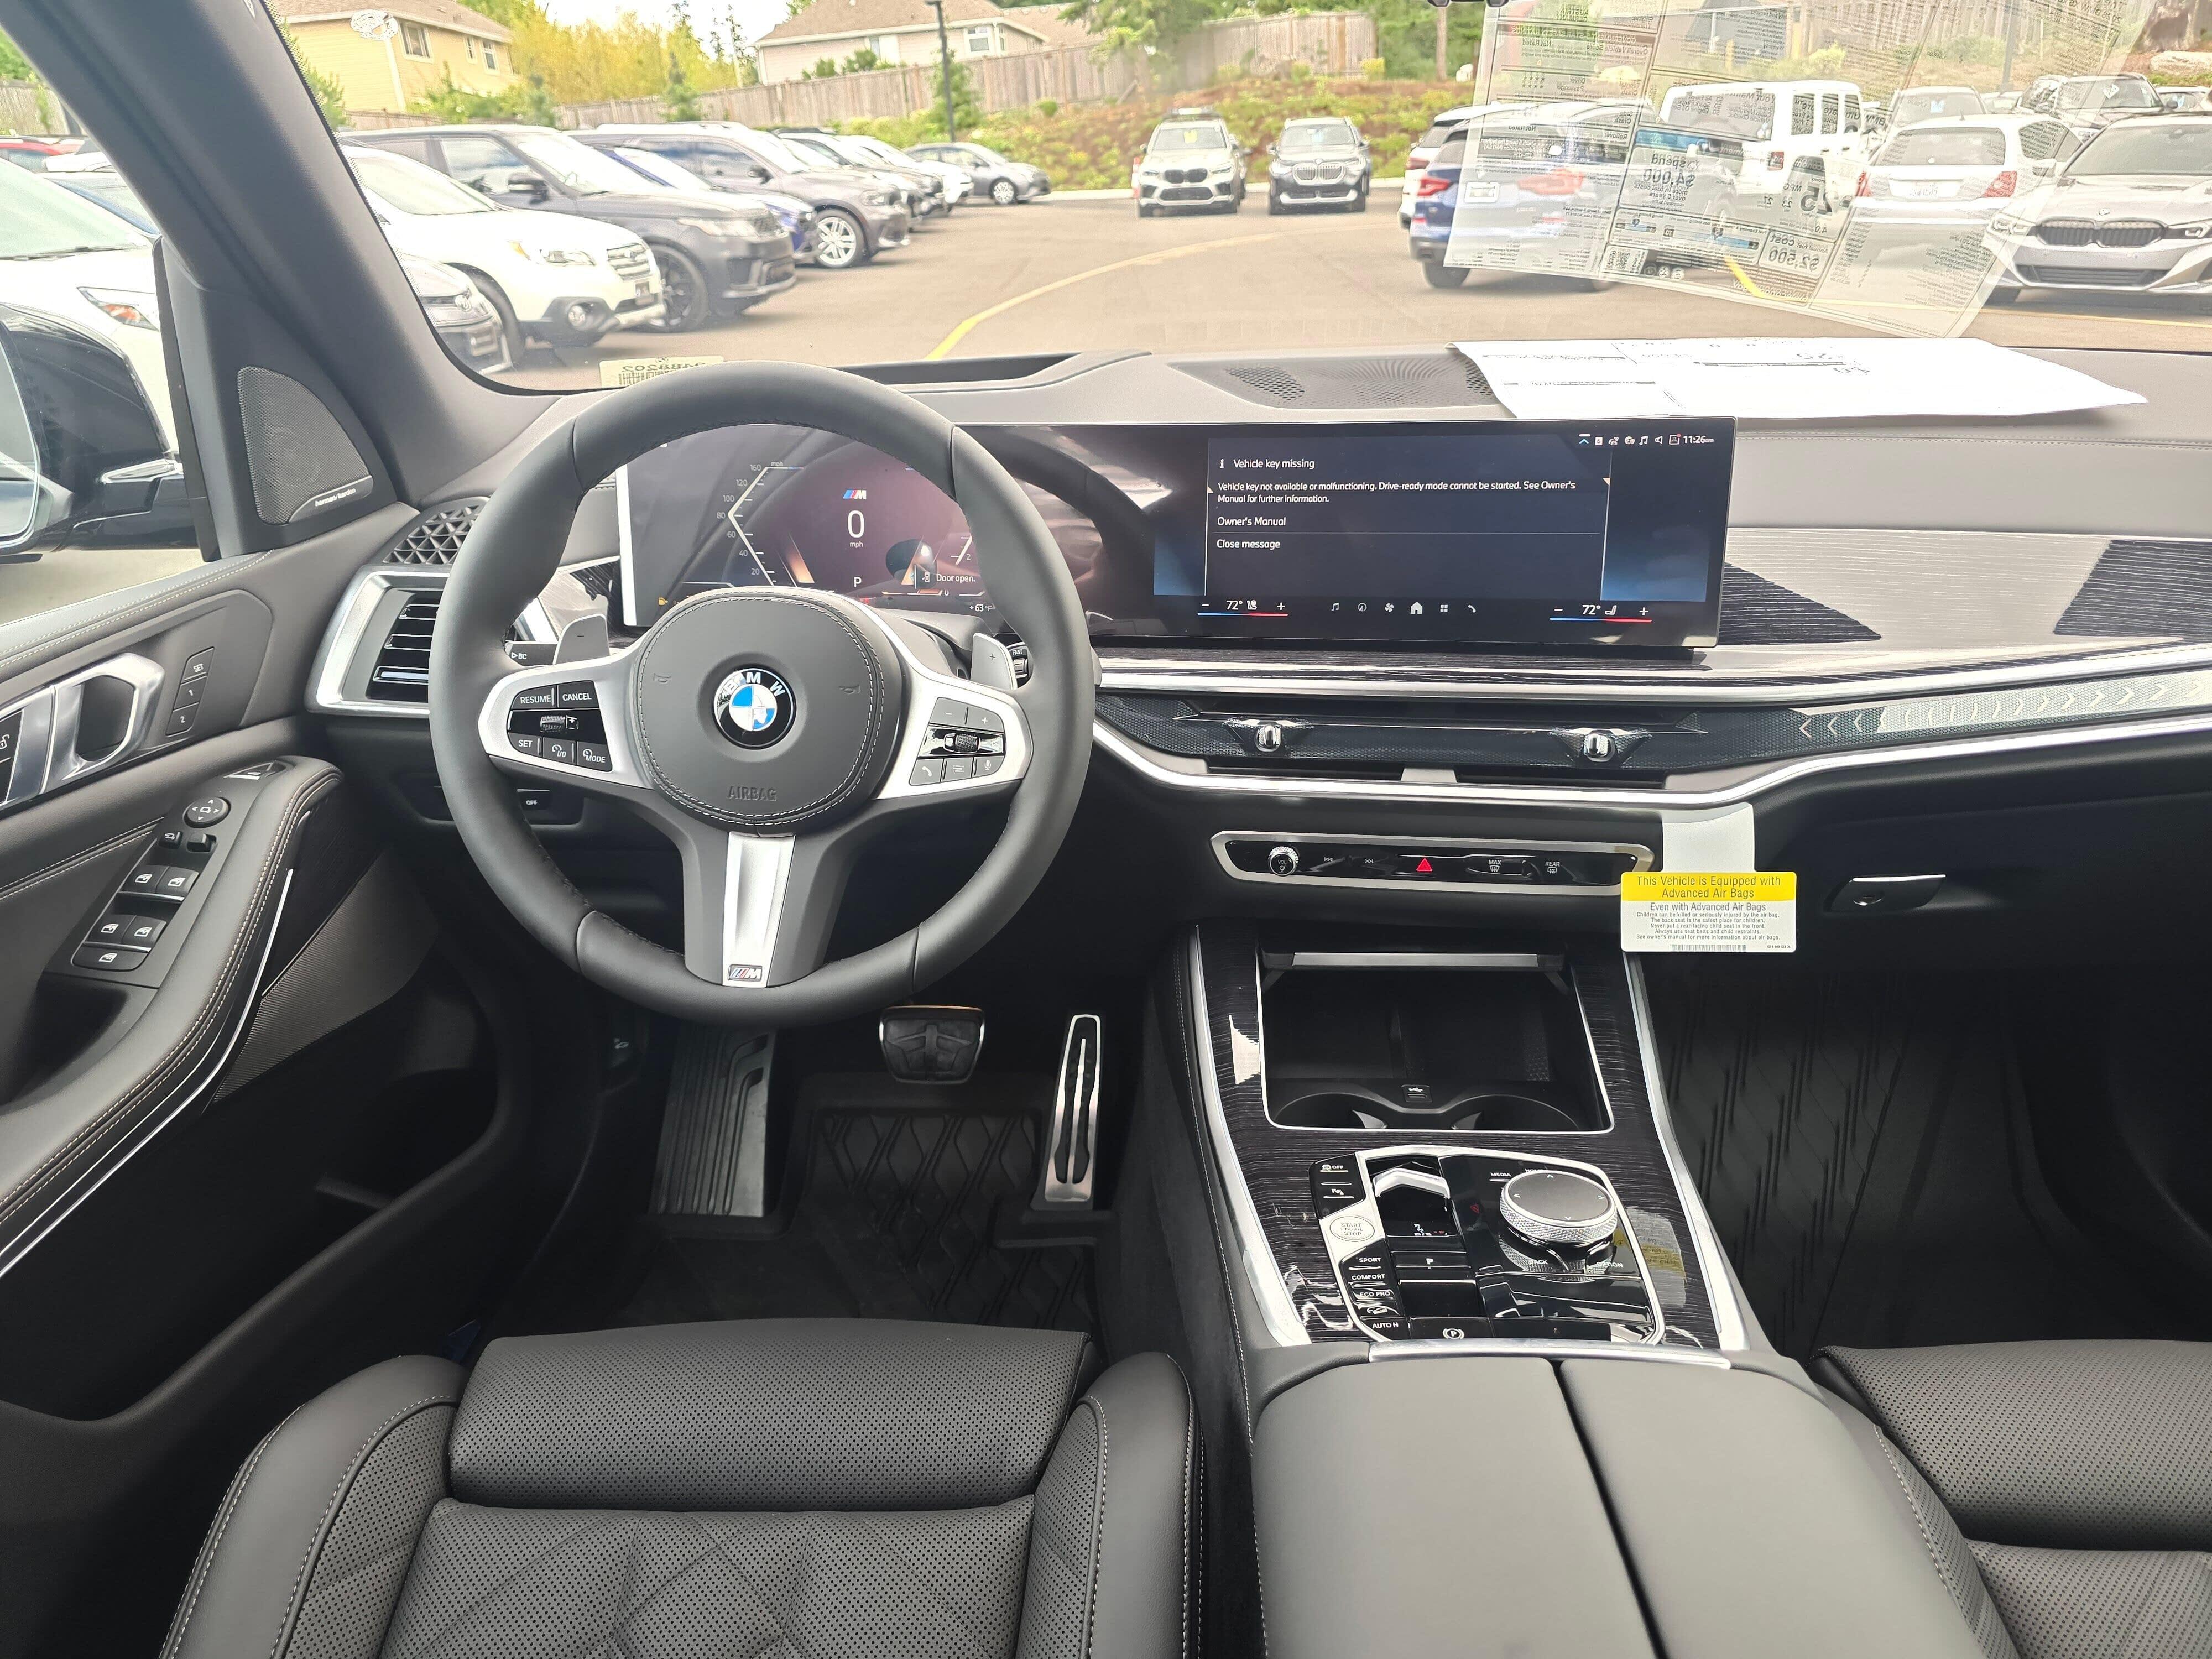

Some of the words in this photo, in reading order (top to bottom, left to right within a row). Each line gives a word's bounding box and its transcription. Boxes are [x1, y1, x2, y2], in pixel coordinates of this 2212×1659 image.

[1683, 435, 1715, 444] 11:26am
[1233, 458, 1264, 468] Vehicle
[1265, 458, 1280, 469] key
[1281, 458, 1315, 469] missing
[1218, 482, 1244, 491] Vehicle
[1246, 482, 1259, 492] key
[1274, 482, 1308, 491] available
[1318, 482, 1377, 492] malfunctioning.
[1379, 482, 1424, 491] Drive-ready
[1425, 482, 1448, 490] mode
[1479, 482, 1489, 490] be
[1490, 481, 1521, 490] started.
[1523, 481, 1540, 489] See
[1541, 481, 1576, 489] Owner's
[1258, 494, 1282, 503] further
[1284, 494, 1329, 503] information.
[847, 510, 865, 538] 0
[1217, 517, 1252, 526] Owner's
[1254, 517, 1286, 526] Manual
[1217, 539, 1240, 549] Close
[1241, 541, 1281, 550] message
[853, 577, 862, 588] P
[936, 574, 955, 582] Door
[956, 575, 975, 583] open.
[193, 663, 204, 672] SET
[725, 671, 786, 697] BMW
[520, 695, 551, 705] RESUME
[562, 692, 592, 701] CANCEL
[518, 739, 533, 748] SET
[585, 755, 606, 763] MODE
[728, 786, 777, 801] AIRBAG
[1637, 876, 1657, 885] This
[1661, 876, 1695, 885] Vehicle
[1699, 876, 1707, 885] is
[1710, 876, 1756, 888] Equipped
[1760, 876, 1780, 885] with
[1662, 888, 1709, 898] Advanced
[1713, 888, 1726, 898] Air
[1730, 888, 1754, 900] Bags
[1650, 902, 1669, 911] Even
[1671, 902, 1688, 911] with
[1691, 902, 1730, 911] Advanced
[1732, 902, 1744, 911] Air
[1746, 902, 1766, 912] Bags
